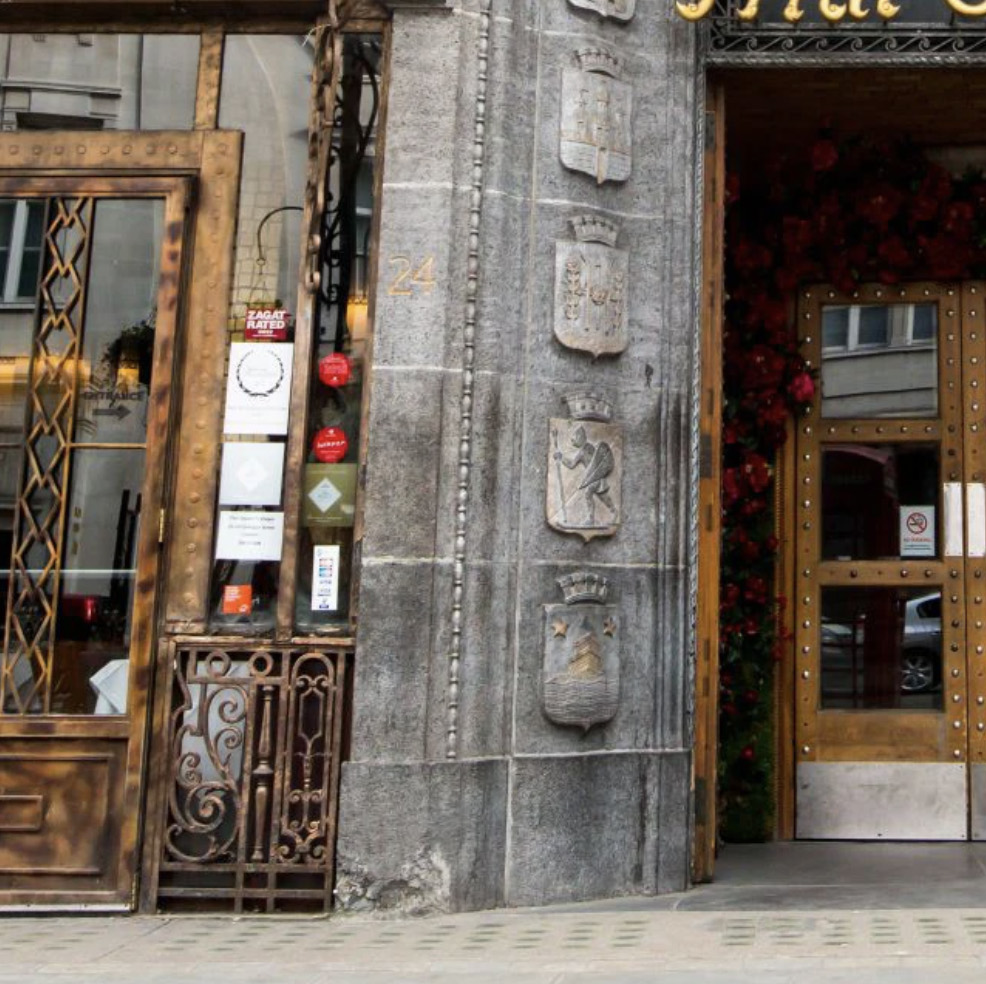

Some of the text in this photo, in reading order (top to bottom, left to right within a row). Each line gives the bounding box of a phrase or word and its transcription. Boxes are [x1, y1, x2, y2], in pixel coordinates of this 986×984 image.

[388, 256, 434, 296] 24
[247, 309, 287, 320] ZAGAT
[246, 320, 286, 330] RATED
